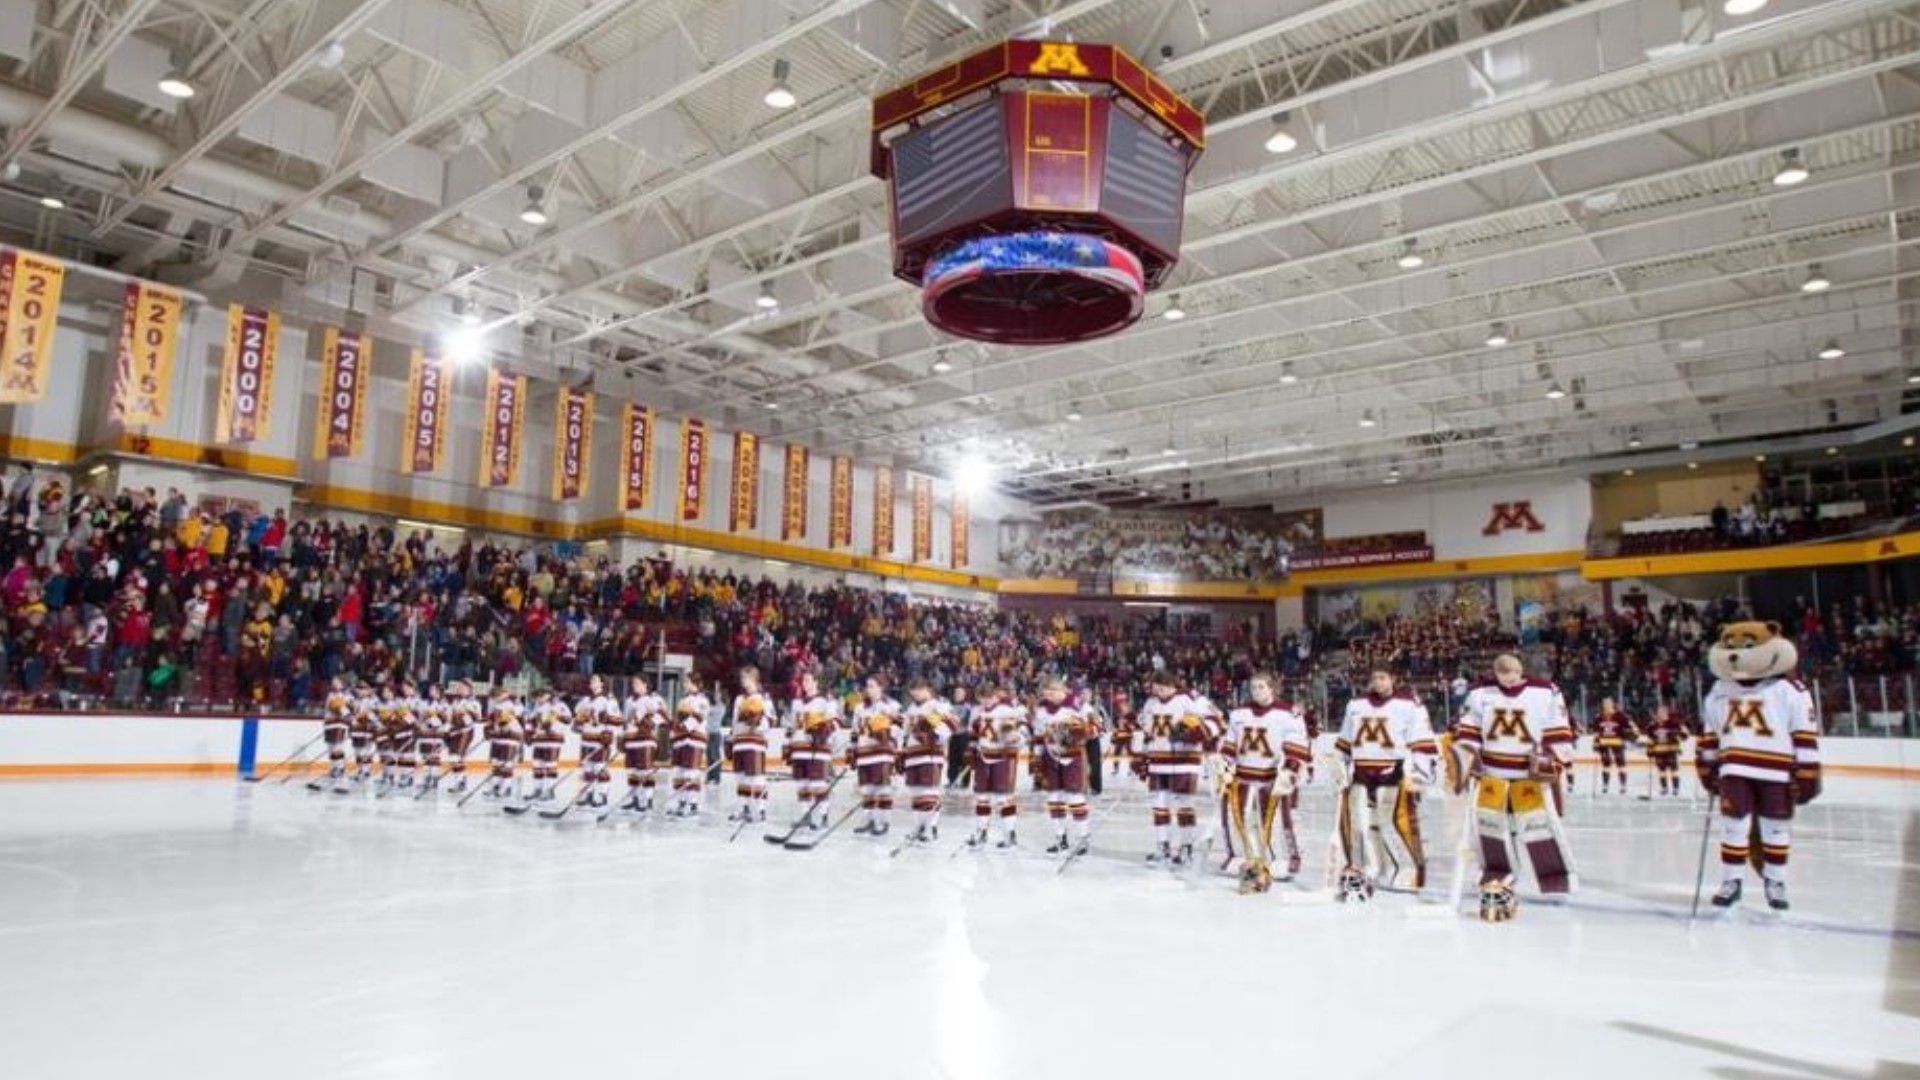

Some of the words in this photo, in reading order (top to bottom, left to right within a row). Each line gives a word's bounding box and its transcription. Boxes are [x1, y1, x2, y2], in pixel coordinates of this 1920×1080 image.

[1030, 43, 1089, 76] M
[14, 275, 46, 369] 2014
[141, 304, 166, 395] 2015
[238, 329, 262, 413] 2000
[333, 350, 355, 430] 2004
[418, 370, 437, 447] 2005
[495, 388, 513, 462] 2012
[566, 405, 581, 475] 2013
[630, 420, 643, 488] 2015
[687, 434, 700, 499] 2016
[1481, 500, 1546, 537] M
[1239, 727, 1274, 757] M
[1354, 717, 1395, 748] M
[1486, 708, 1533, 743] M
[1722, 699, 1774, 736] M
